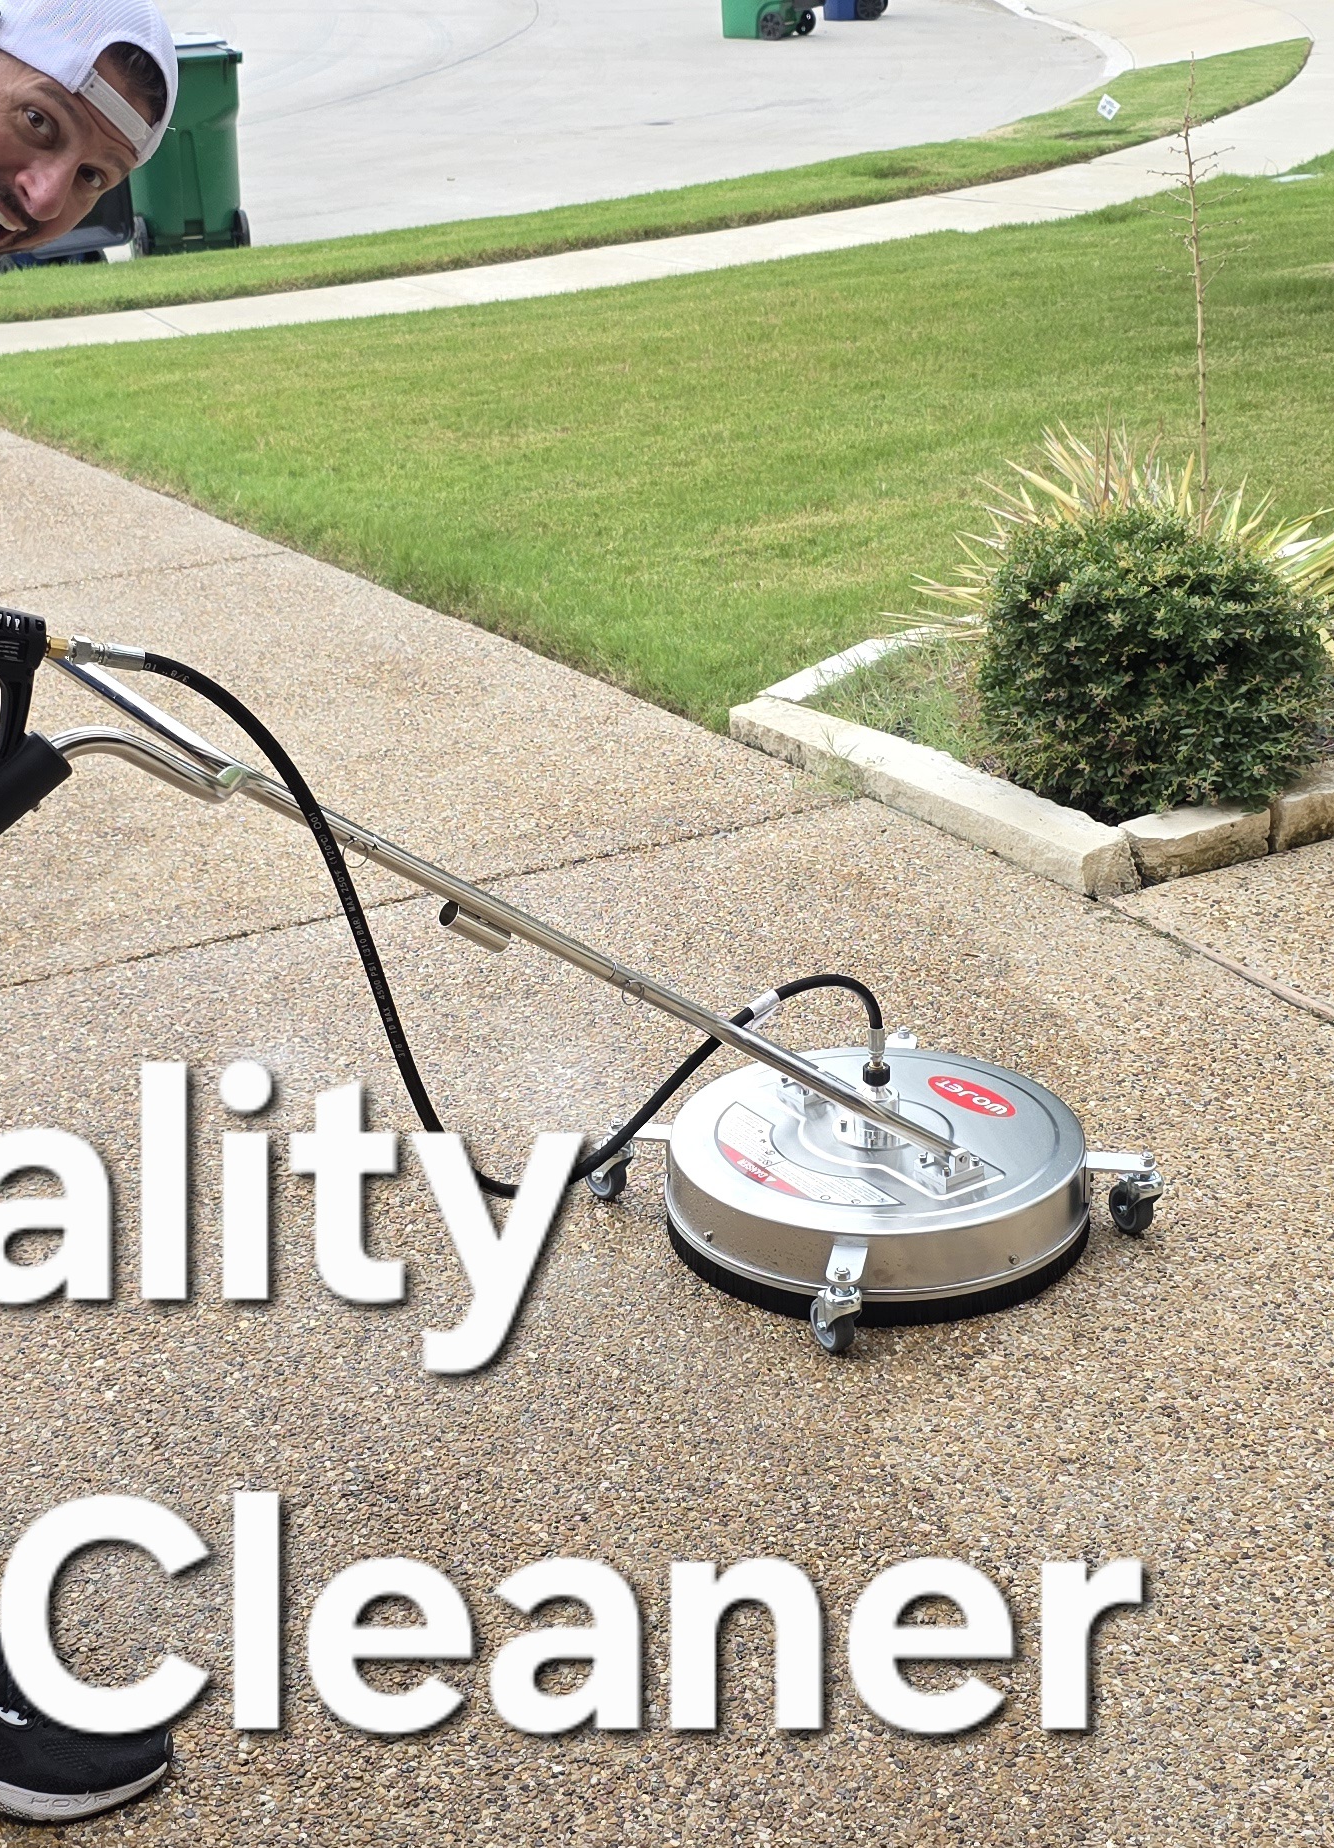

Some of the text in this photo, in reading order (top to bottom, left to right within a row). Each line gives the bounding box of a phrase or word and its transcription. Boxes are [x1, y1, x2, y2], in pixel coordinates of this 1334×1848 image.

[343, 895, 356, 912] MAX
[367, 962, 378, 977] PSI
[373, 979, 385, 1000] 4500
[382, 1006, 395, 1023] MAX
[934, 1079, 1009, 1116] WOJET
